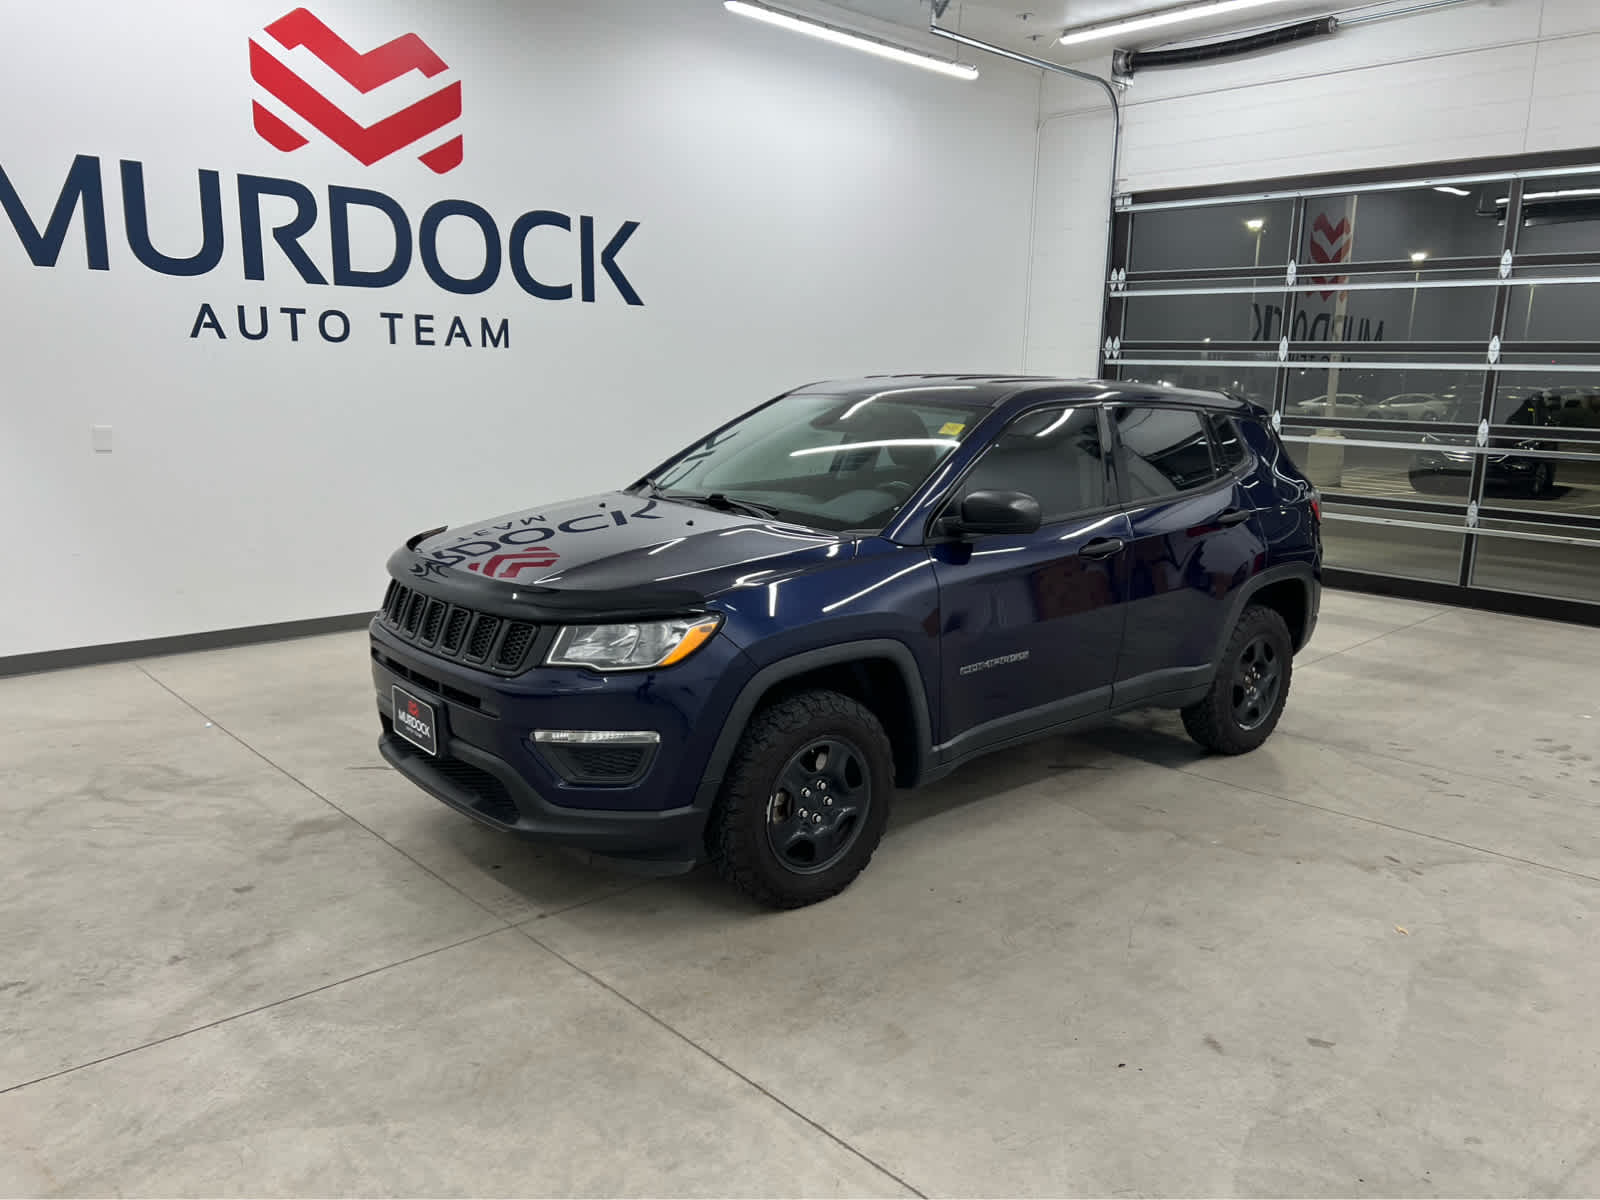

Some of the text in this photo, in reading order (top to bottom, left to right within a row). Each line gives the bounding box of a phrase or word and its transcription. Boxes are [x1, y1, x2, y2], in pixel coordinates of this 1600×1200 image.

[0, 154, 645, 306] MURDOCK
[190, 303, 511, 348] AUTO TEAM
